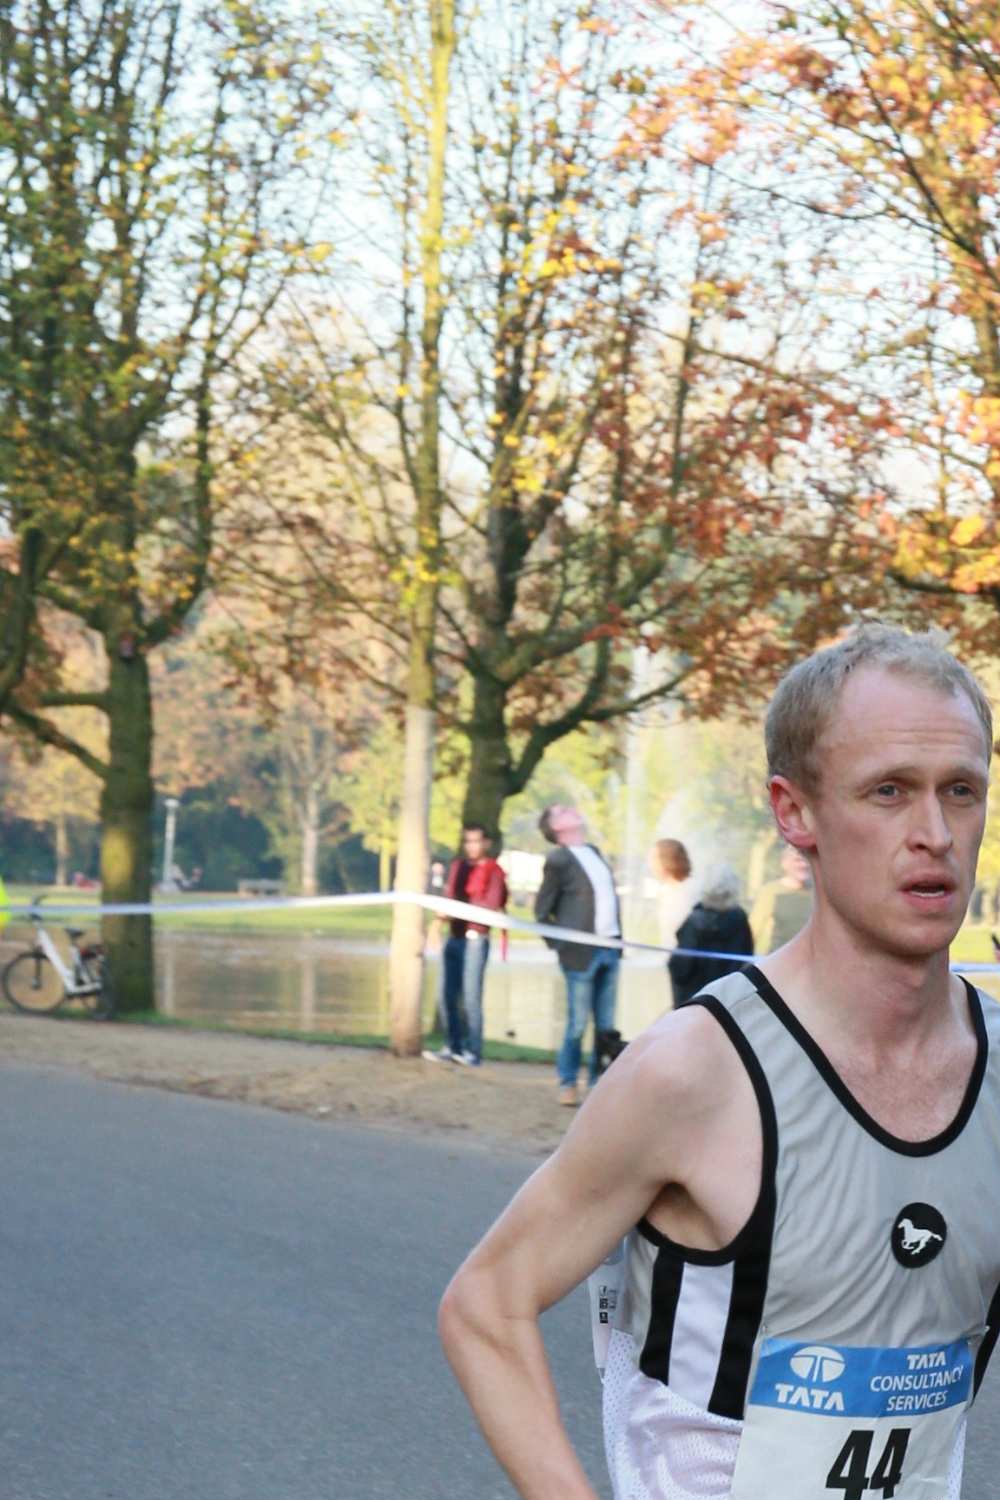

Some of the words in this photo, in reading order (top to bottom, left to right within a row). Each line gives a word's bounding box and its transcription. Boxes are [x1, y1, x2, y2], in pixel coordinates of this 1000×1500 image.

[906, 1351, 947, 1370] TATA
[870, 1364, 964, 1393] CONSULTANCY
[774, 1383, 845, 1412] TATA
[886, 1390, 949, 1412] SERVICES
